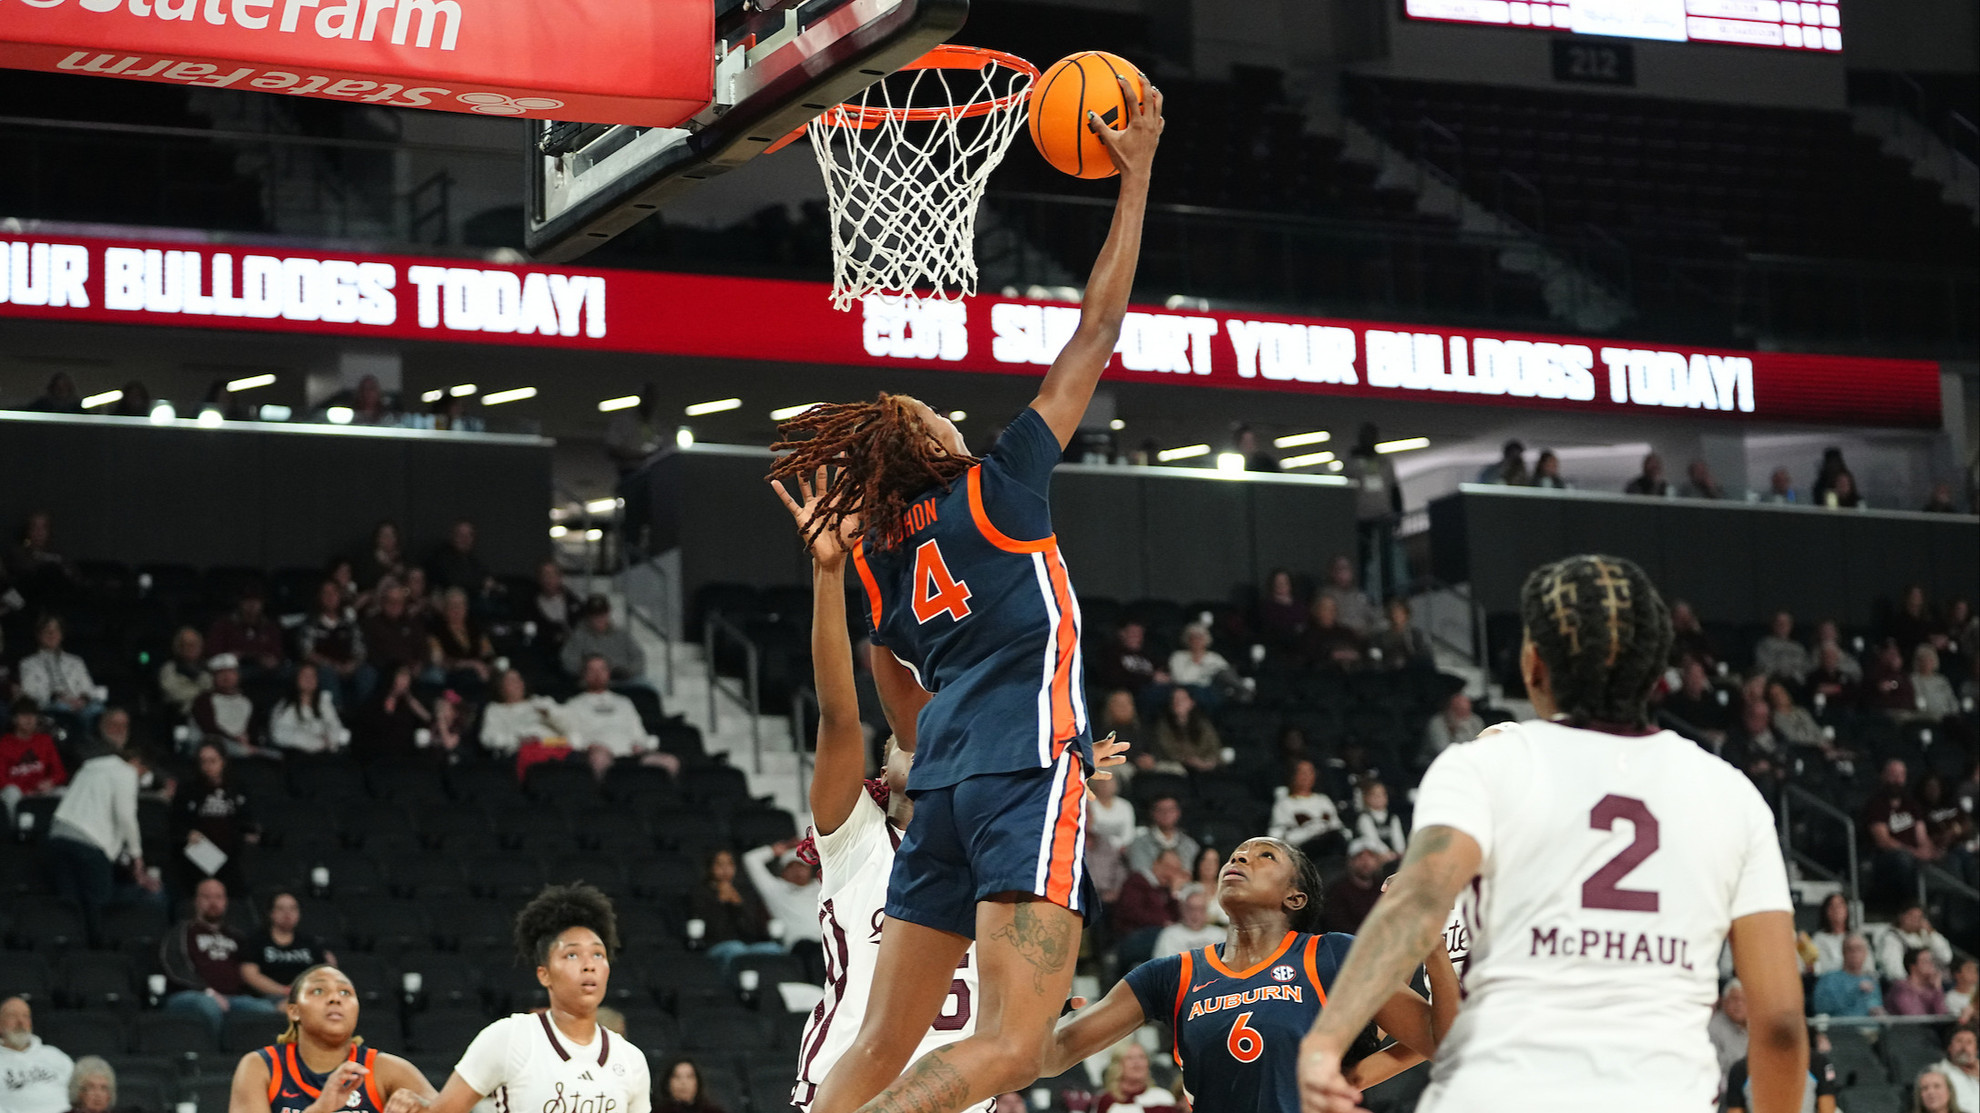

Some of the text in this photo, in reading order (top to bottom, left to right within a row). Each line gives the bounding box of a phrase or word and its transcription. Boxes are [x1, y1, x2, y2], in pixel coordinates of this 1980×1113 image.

[1567, 46, 1619, 77] 212
[104, 247, 397, 326] BULLDOGS
[991, 303, 1219, 376] SUORT
[1225, 319, 1359, 385] YOUR
[1365, 329, 1596, 401] BULLDOGS
[911, 538, 973, 625] 4
[1581, 793, 1660, 913] 2
[1272, 965, 1295, 981] SEC
[1529, 926, 1694, 971] McPHAUL
[1187, 984, 1303, 1022] AUBURN
[1227, 1011, 1264, 1064] 6
[543, 1081, 617, 1113] State
